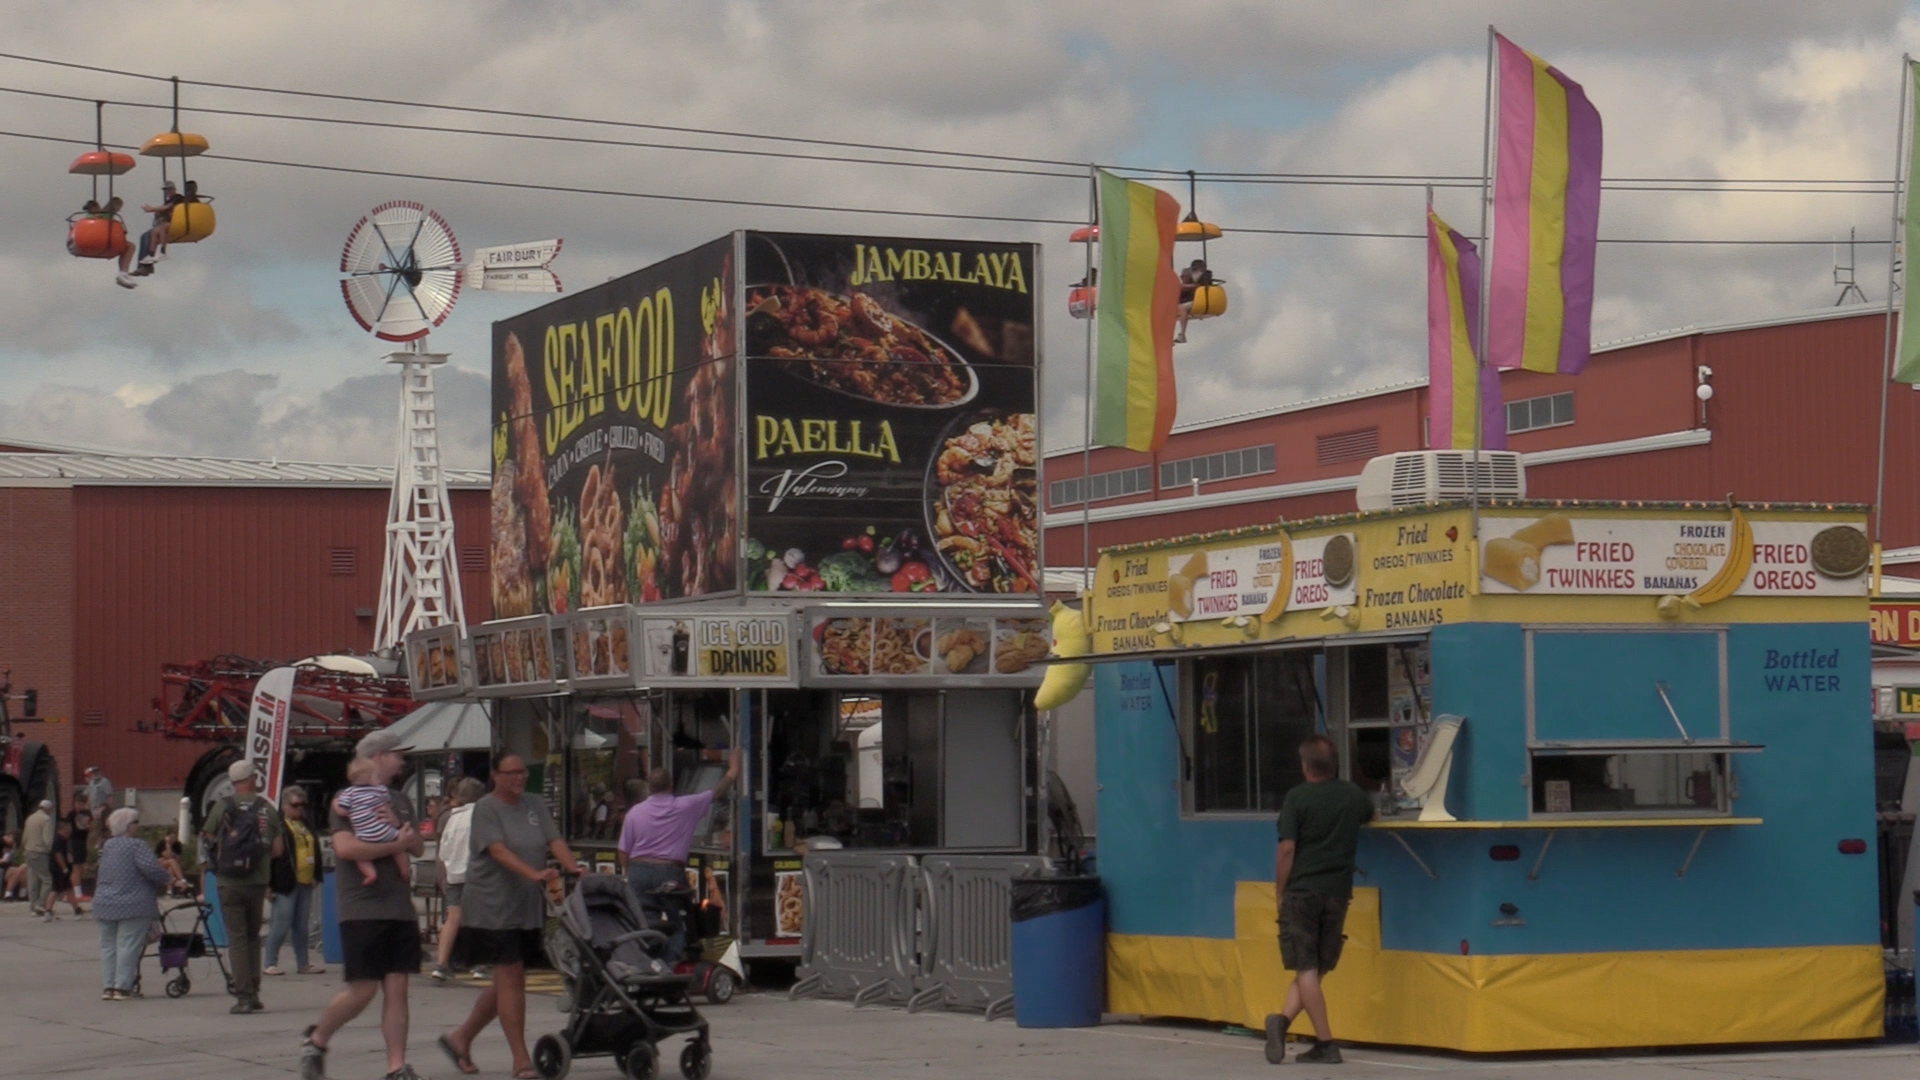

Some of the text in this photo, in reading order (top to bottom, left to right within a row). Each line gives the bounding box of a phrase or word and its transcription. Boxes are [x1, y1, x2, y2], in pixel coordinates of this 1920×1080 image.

[489, 249, 542, 264] FAIRBURY
[850, 243, 1028, 294] JAMBALAYA
[544, 286, 674, 456] SEAFOOD
[644, 432, 665, 463] FRIED
[756, 415, 901, 463] PAELLA
[1397, 523, 1428, 546] Fried
[1680, 525, 1726, 538] FROZEN
[1577, 542, 1635, 562] FRIED
[1674, 543, 1726, 557] CHOCOLATE
[1753, 544, 1808, 564] FRIED
[1125, 558, 1149, 578] Fried
[1294, 558, 1324, 579] FRIED
[1210, 569, 1238, 589] FRIED
[1546, 569, 1635, 589] TWINKIES
[1644, 576, 1698, 589] BANANAS
[1753, 570, 1817, 590] OREOS
[1197, 593, 1238, 614] TWINKIES
[1295, 583, 1329, 604] OREOS
[1364, 580, 1465, 608] Frozen Chocolate
[1096, 615, 1126, 632] Frozen
[1385, 608, 1443, 628] BANANAS
[702, 619, 783, 646] ICE COLD
[1113, 635, 1155, 651] BANANAS
[710, 649, 776, 675] DRINKS
[1763, 649, 1839, 669] Bottled
[1764, 675, 1840, 692] WATER
[252, 717, 273, 793] CASE
